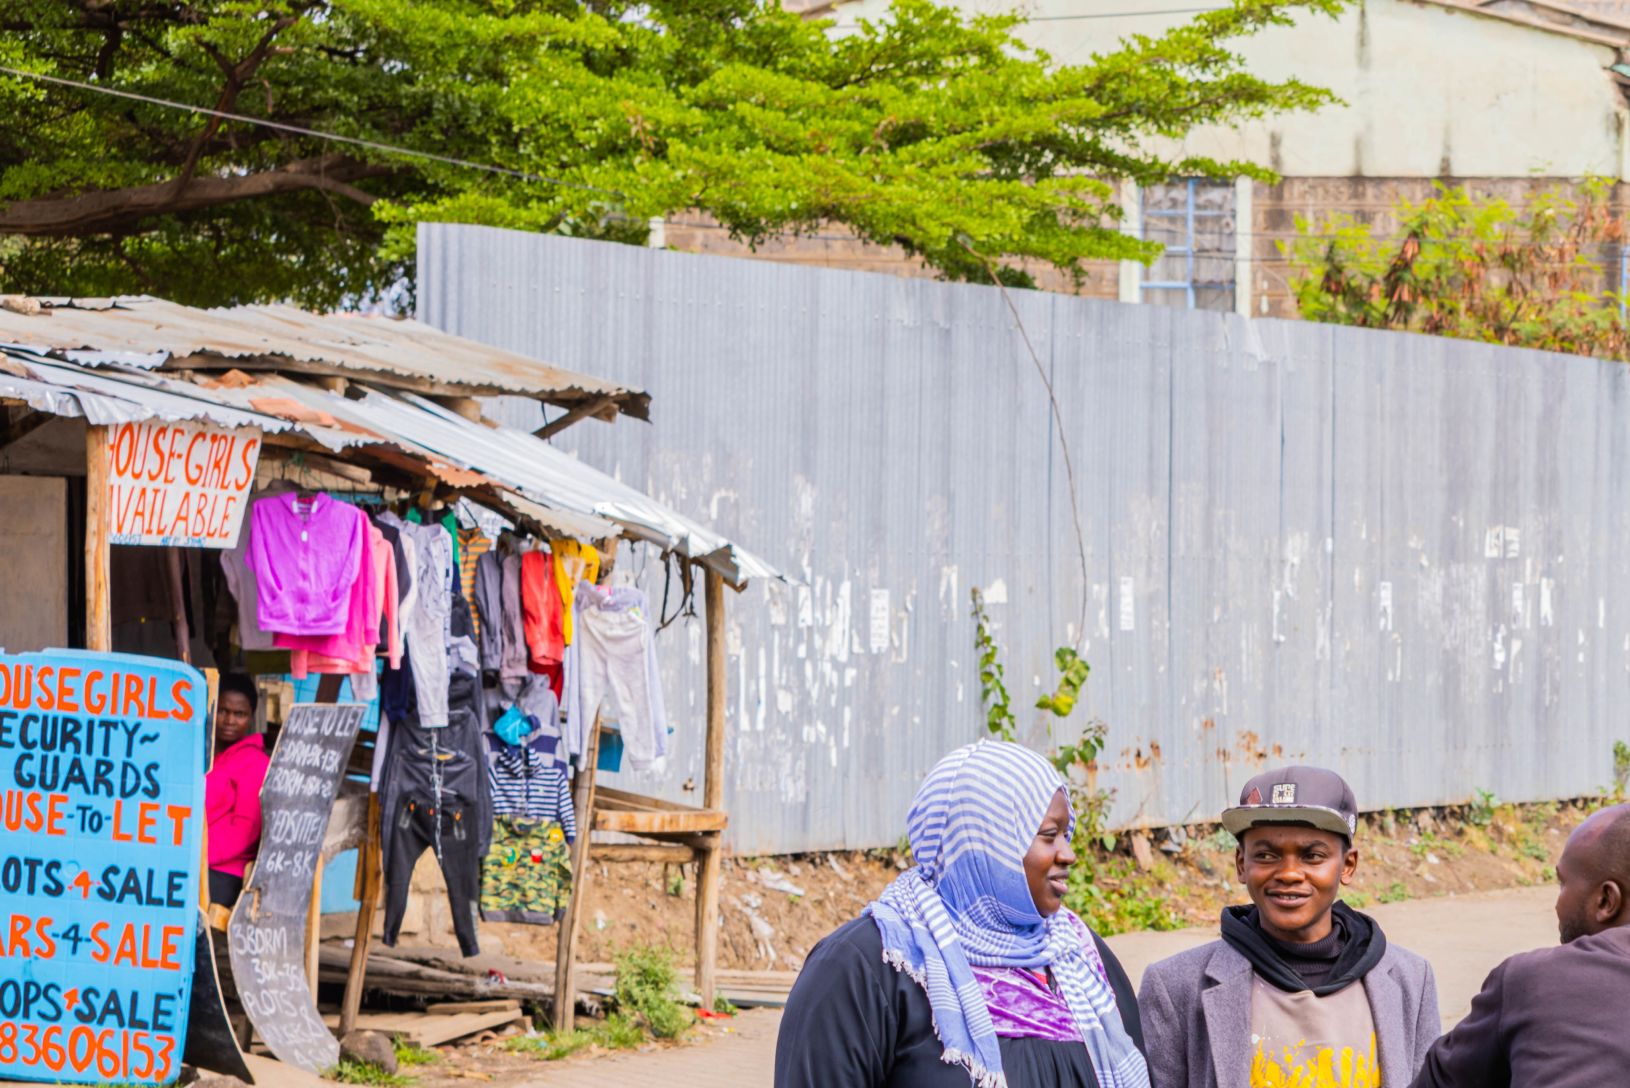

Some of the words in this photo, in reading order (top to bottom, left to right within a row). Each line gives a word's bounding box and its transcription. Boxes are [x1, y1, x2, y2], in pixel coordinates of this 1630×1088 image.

[14, 753, 160, 799] GUARDS
[266, 850, 313, 878] 6K-8K
[74, 985, 176, 1032] SALE
[244, 989, 298, 1018] PLOTS
